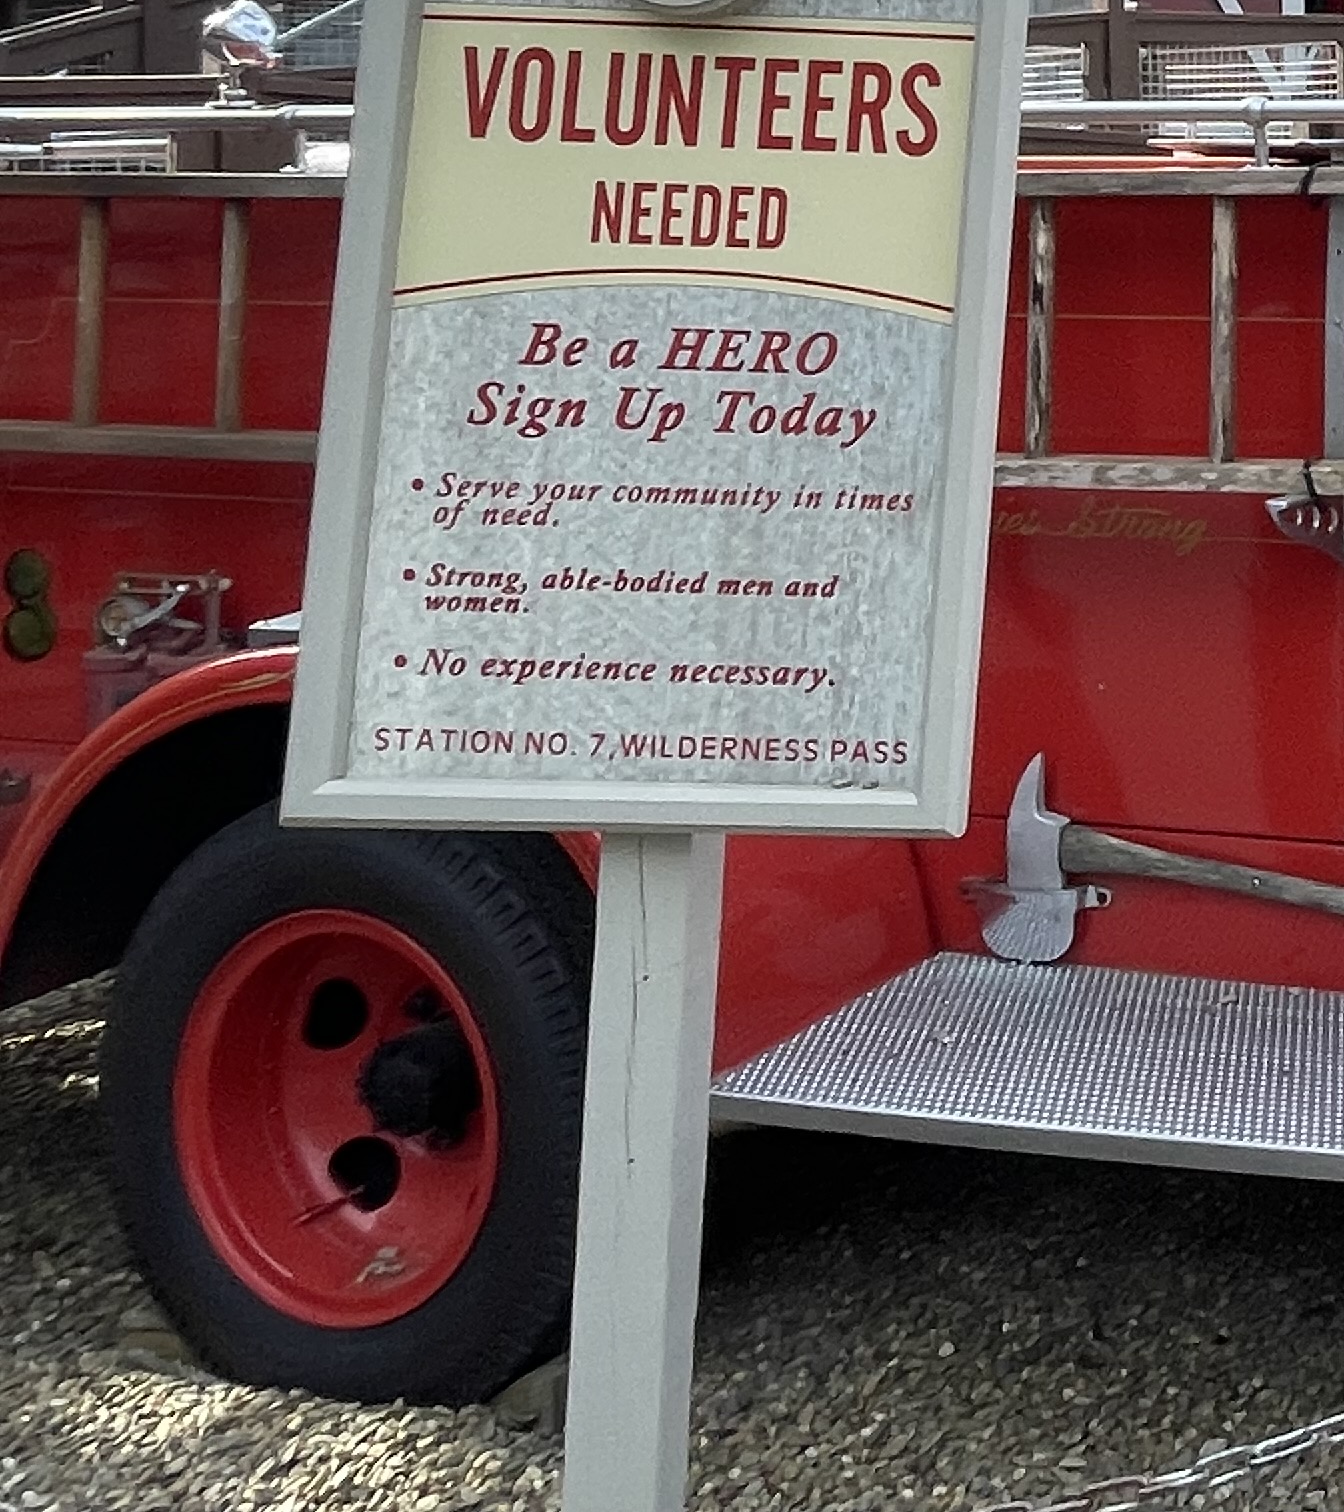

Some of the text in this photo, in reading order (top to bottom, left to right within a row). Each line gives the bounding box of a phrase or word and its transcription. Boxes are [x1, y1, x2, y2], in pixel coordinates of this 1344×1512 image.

[462, 44, 942, 158] VOLUNTEERS
[589, 180, 788, 251] NEEDED
[518, 321, 840, 377] Be a HERO
[466, 380, 879, 449] Sign Up Today
[435, 472, 915, 514] Serve your community in times
[432, 501, 561, 530] of need.
[424, 562, 840, 599] Strong, able-bodied men and
[424, 593, 531, 615] women.
[417, 648, 838, 694] No experience necessary.
[373, 726, 515, 756] STATION
[523, 730, 578, 757] NO.
[620, 733, 820, 763] WILDERNESS
[829, 739, 910, 765] PASS
